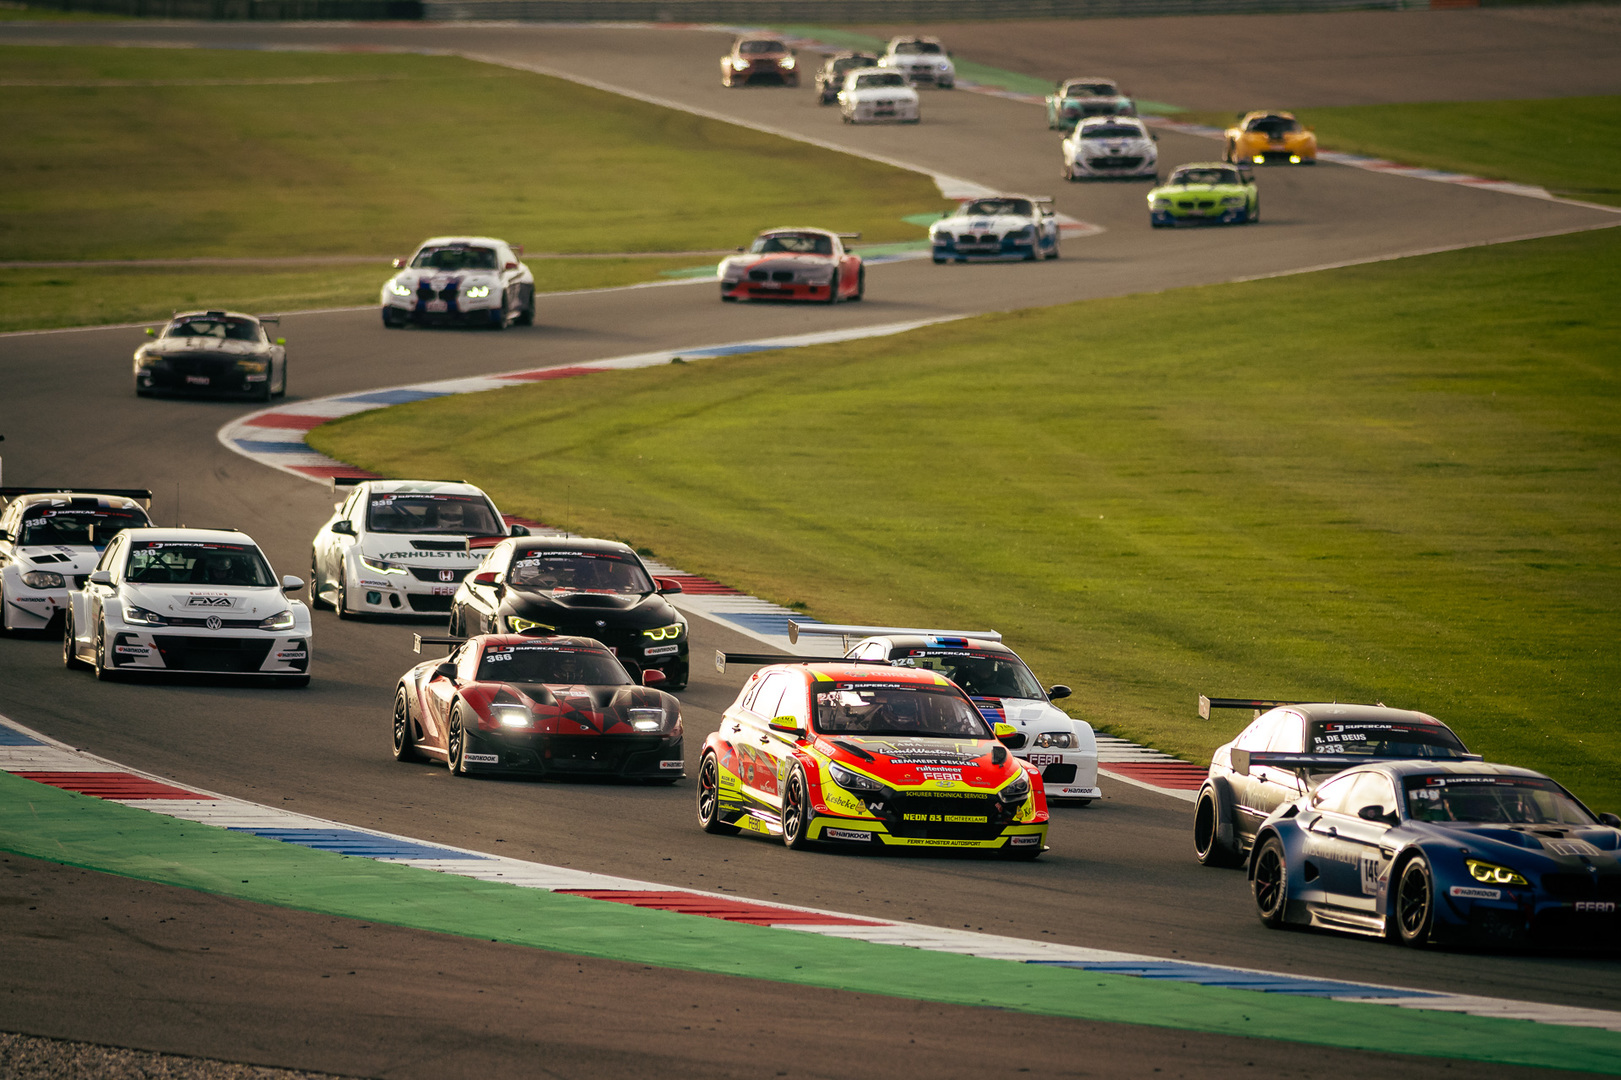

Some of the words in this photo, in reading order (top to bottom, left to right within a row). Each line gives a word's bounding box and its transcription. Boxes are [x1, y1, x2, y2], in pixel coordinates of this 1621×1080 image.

[379, 551, 453, 560] VERHULST
[486, 653, 513, 663] 366
[1314, 736, 1326, 744] R.
[1326, 735, 1341, 743] DE
[1341, 733, 1367, 742] BEUS
[1315, 744, 1345, 754] 233
[940, 759, 979, 767] DEKKER
[933, 791, 963, 799] TECHNICAL
[963, 792, 988, 800] SERVICES
[825, 792, 856, 810] Kesbeke
[903, 813, 928, 821] NEON
